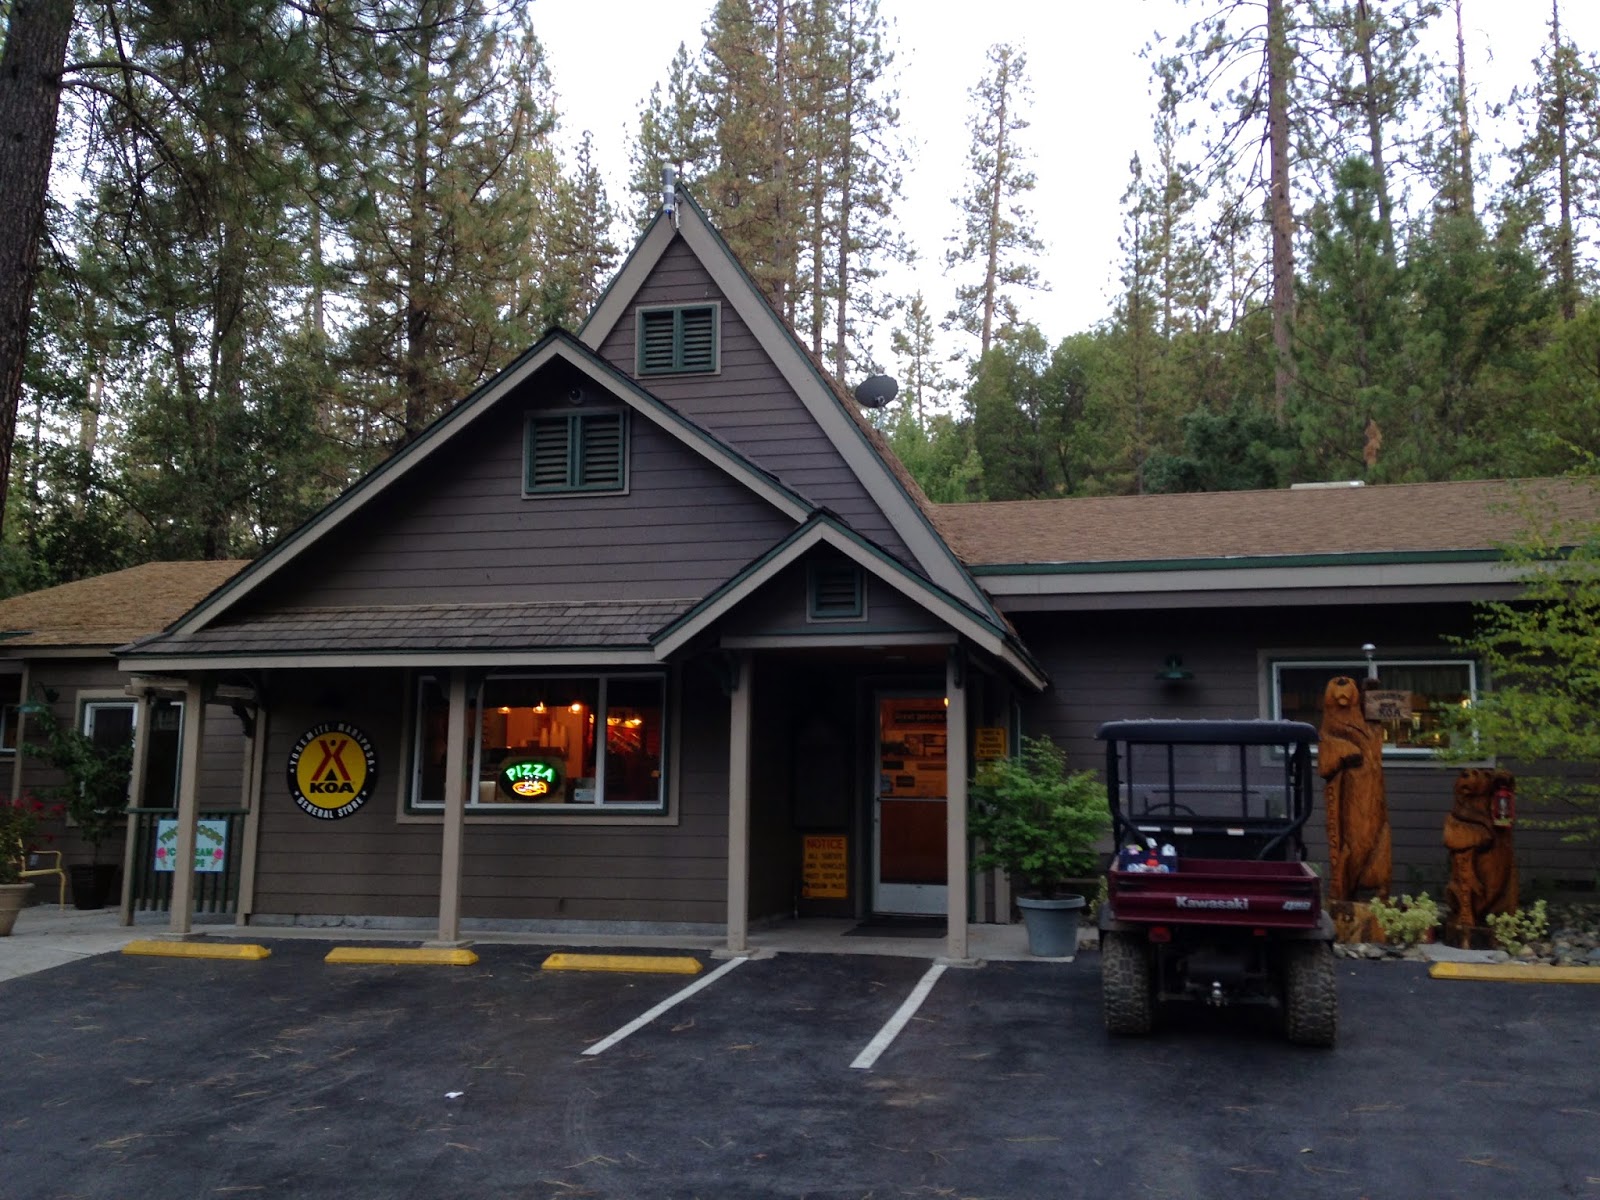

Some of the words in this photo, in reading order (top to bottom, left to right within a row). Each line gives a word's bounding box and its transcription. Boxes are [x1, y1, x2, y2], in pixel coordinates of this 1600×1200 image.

[289, 723, 330, 766] YOSEMITE
[337, 722, 376, 766] MARIPOSA
[505, 763, 554, 783] PIZZA
[309, 782, 355, 794] KOA
[296, 796, 335, 819] GENERAL
[337, 796, 364, 818] STORE
[806, 838, 844, 850] NOTICE
[1175, 895, 1249, 911] Kawasaki
